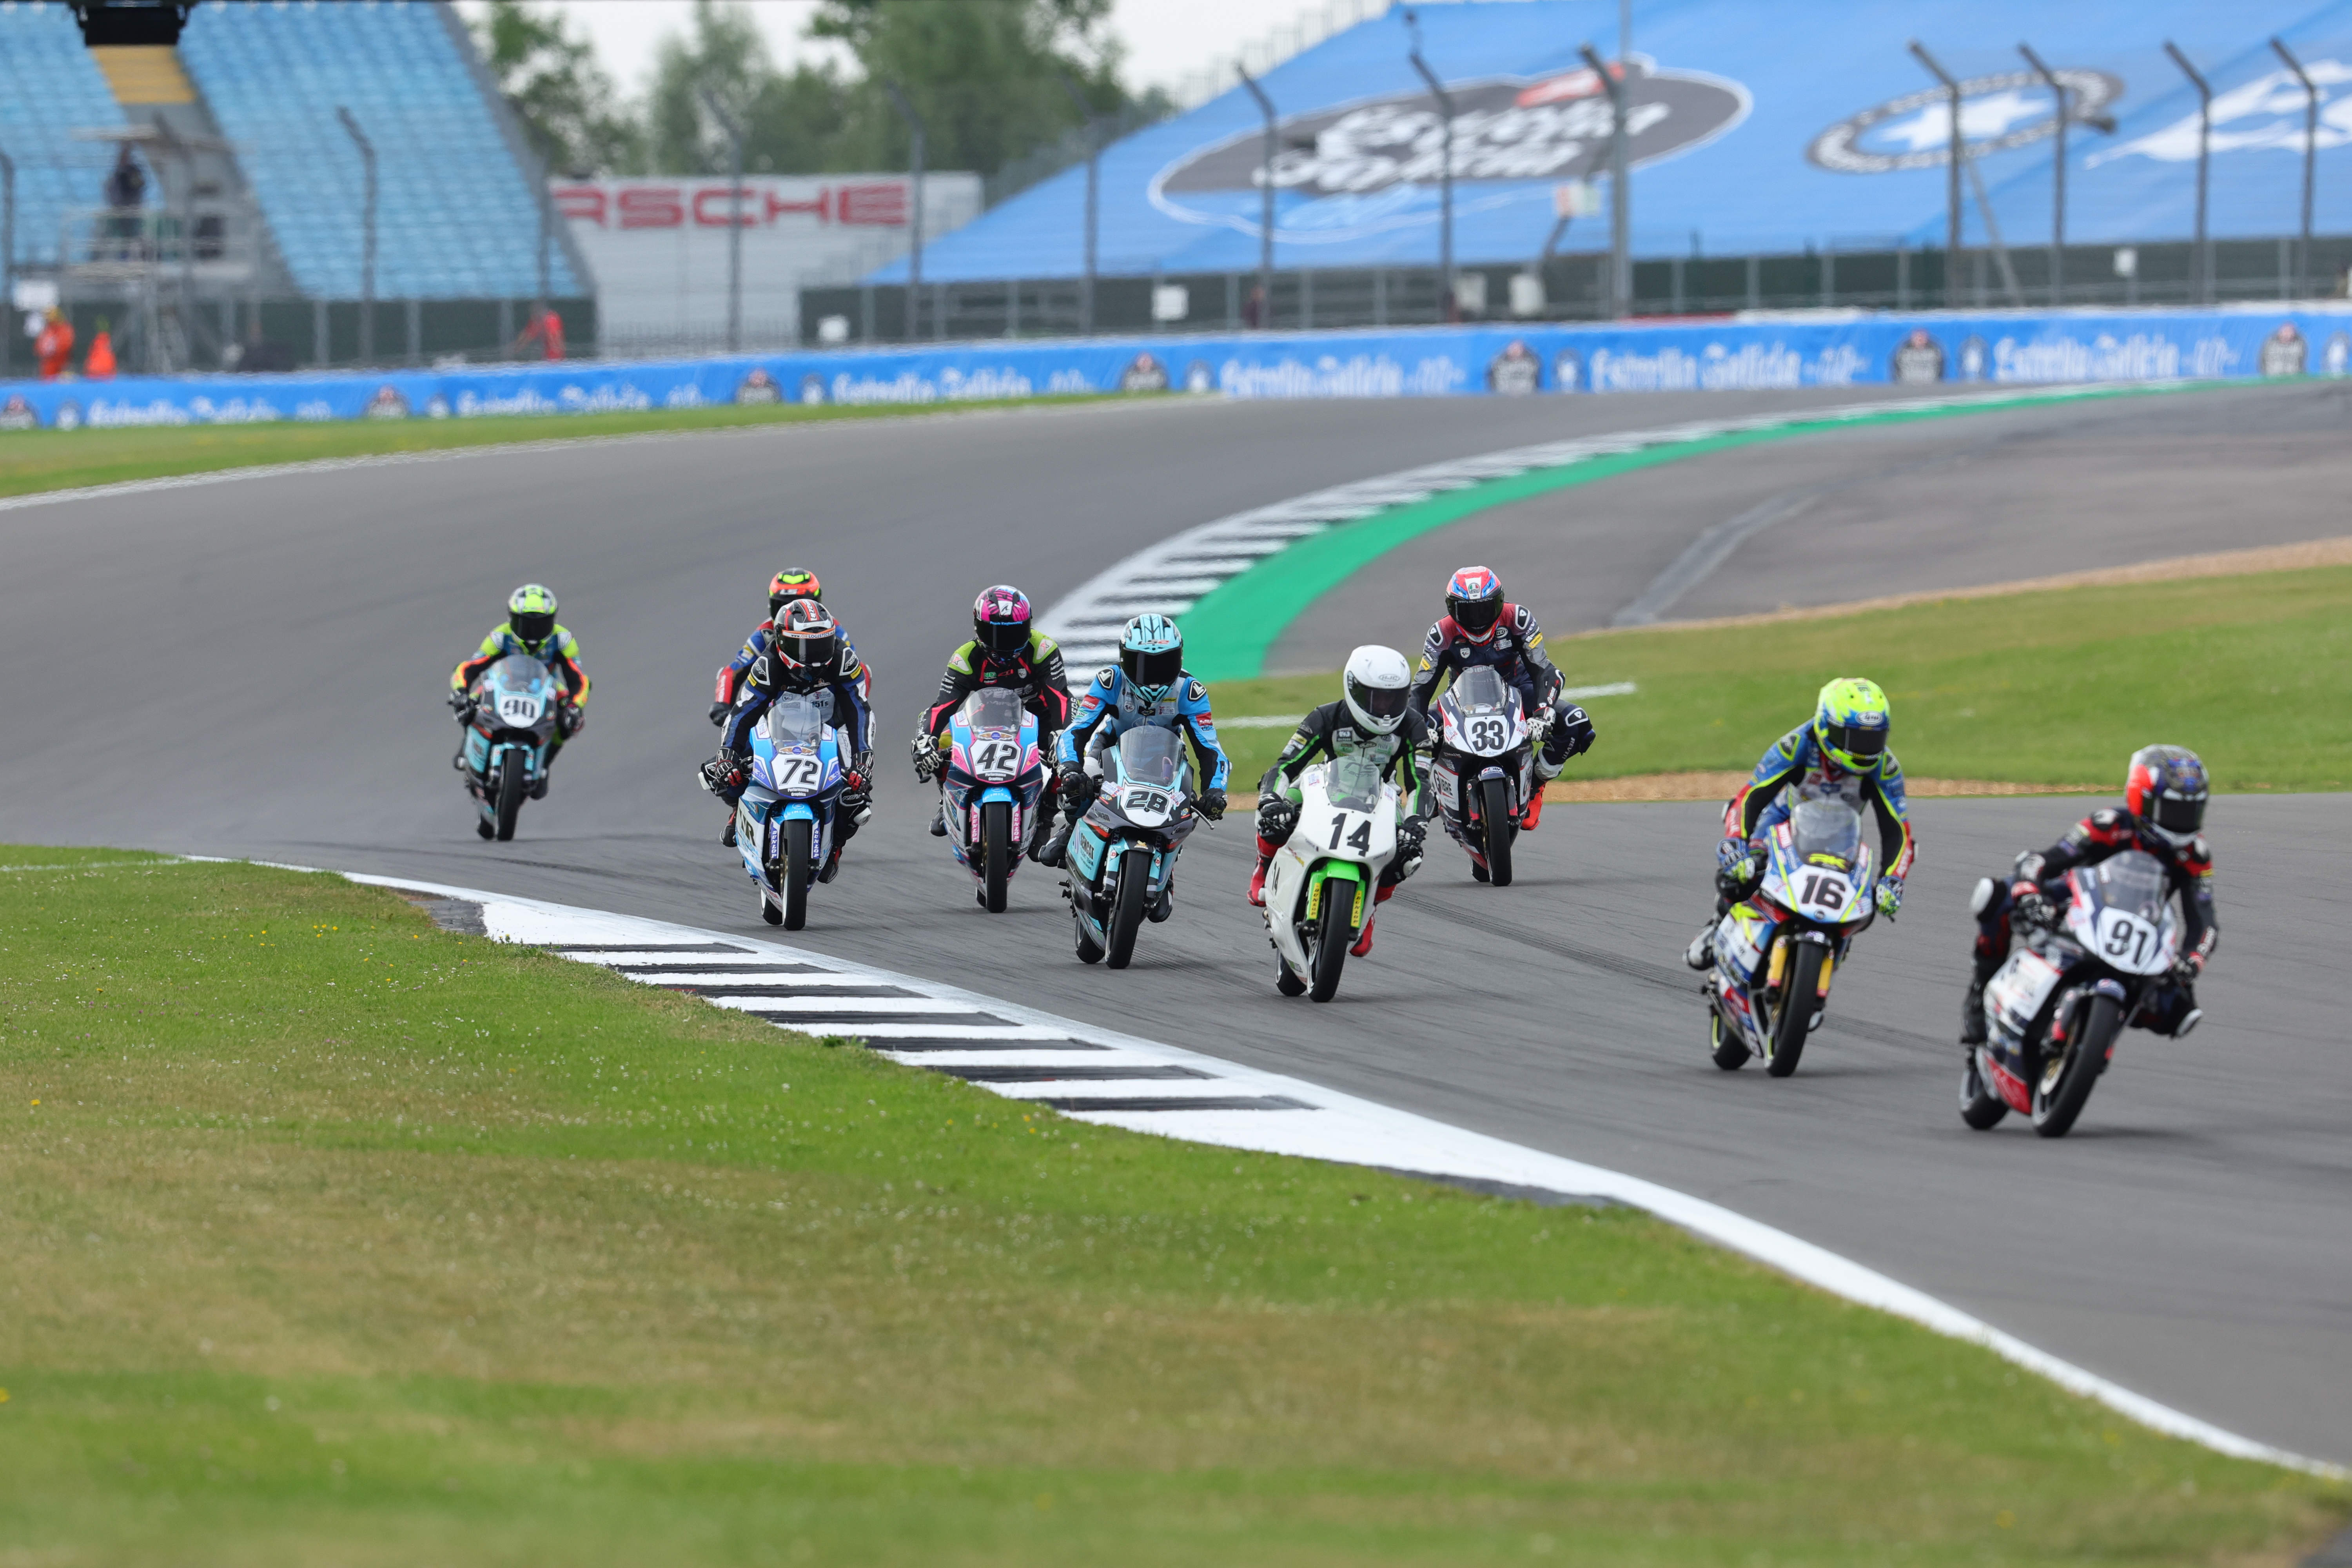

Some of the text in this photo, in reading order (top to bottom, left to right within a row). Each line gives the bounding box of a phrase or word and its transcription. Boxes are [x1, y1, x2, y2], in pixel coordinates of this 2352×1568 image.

[551, 181, 906, 229] RSCHE
[504, 699, 535, 718] 90
[1472, 720, 1504, 751] 33
[780, 759, 818, 786] 72
[975, 743, 1018, 772] 42
[1125, 790, 1169, 815] 28
[1329, 813, 1372, 857] 14
[1272, 861, 1281, 896] 14
[1801, 875, 1846, 910] 16
[2105, 919, 2150, 966] 91
